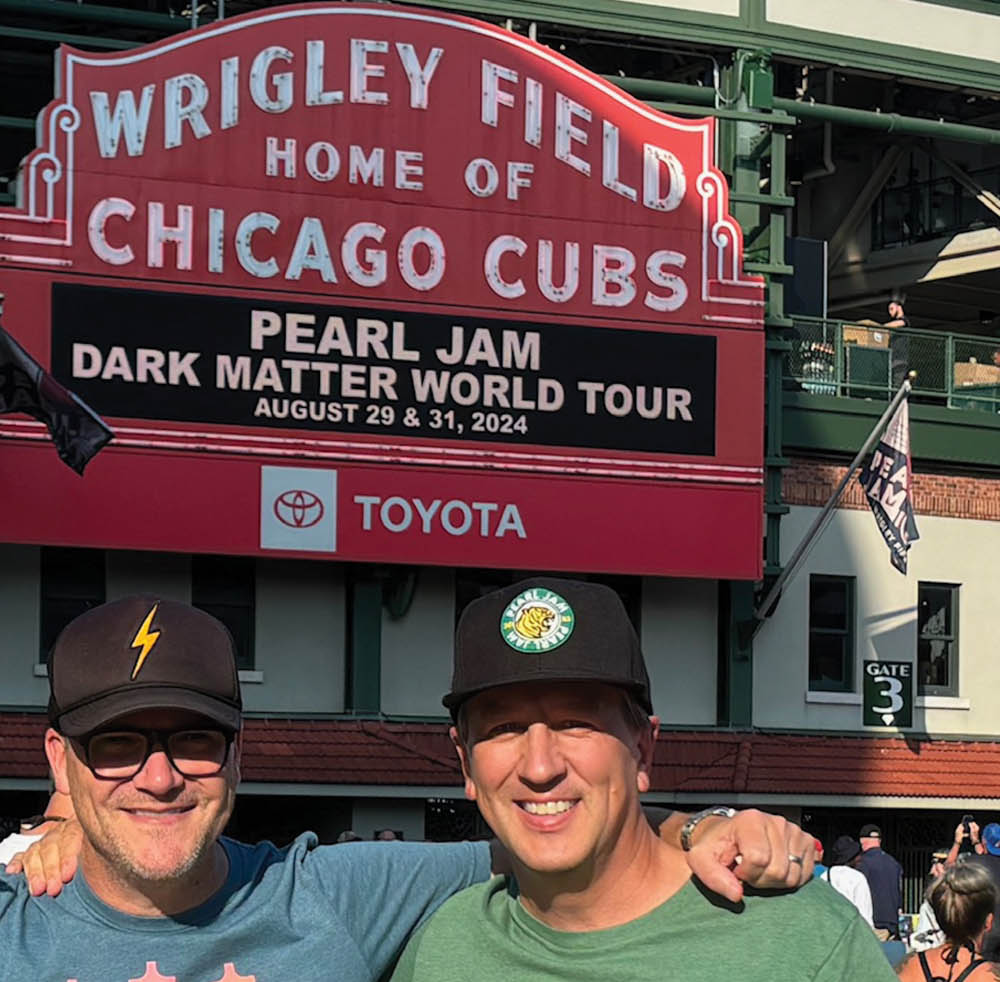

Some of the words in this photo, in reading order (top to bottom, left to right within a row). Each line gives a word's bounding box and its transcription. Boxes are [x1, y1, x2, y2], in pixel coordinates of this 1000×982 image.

[89, 38, 445, 159] WRIGLEY
[481, 58, 688, 213] FIELD
[264, 137, 425, 192] HOME
[464, 157, 536, 201] OF
[87, 197, 447, 293] CHICAGO
[484, 234, 689, 313] CUBS
[250, 309, 420, 362] PEARL
[435, 325, 541, 371] JAM
[72, 342, 202, 388] DARK
[215, 354, 400, 401] MATTER
[411, 367, 565, 412] WORLD
[577, 380, 694, 422] TOUR
[254, 397, 360, 424] AUGUST
[366, 404, 396, 427] 29
[402, 407, 421, 428] &
[429, 409, 464, 434] 31,
[471, 413, 529, 435] 2024
[354, 495, 527, 539] TOYOTA
[866, 662, 911, 677] GATE
[872, 676, 904, 714] 3
